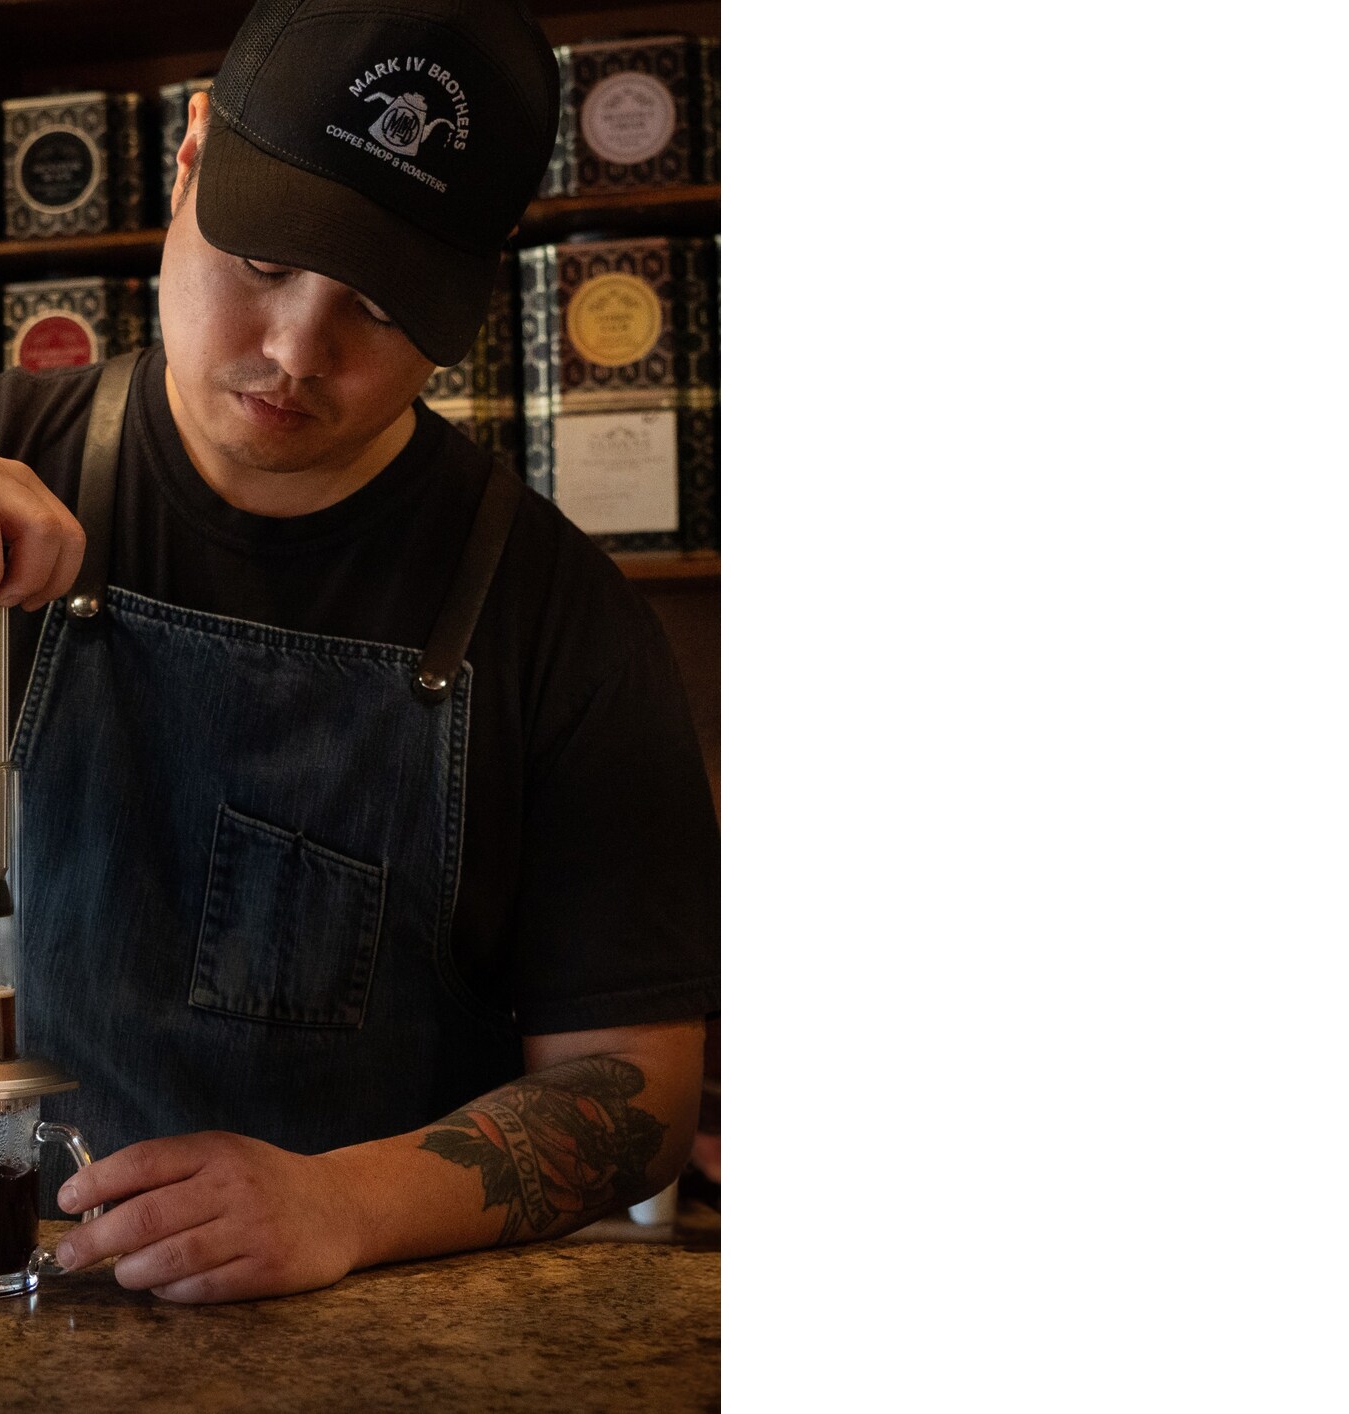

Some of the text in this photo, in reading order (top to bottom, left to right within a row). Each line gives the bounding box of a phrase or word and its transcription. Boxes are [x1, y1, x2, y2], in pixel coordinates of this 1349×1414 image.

[349, 56, 470, 150] MARK IV BROTHERS
[326, 124, 448, 193] COFFEE SHOP & ROASTERS
